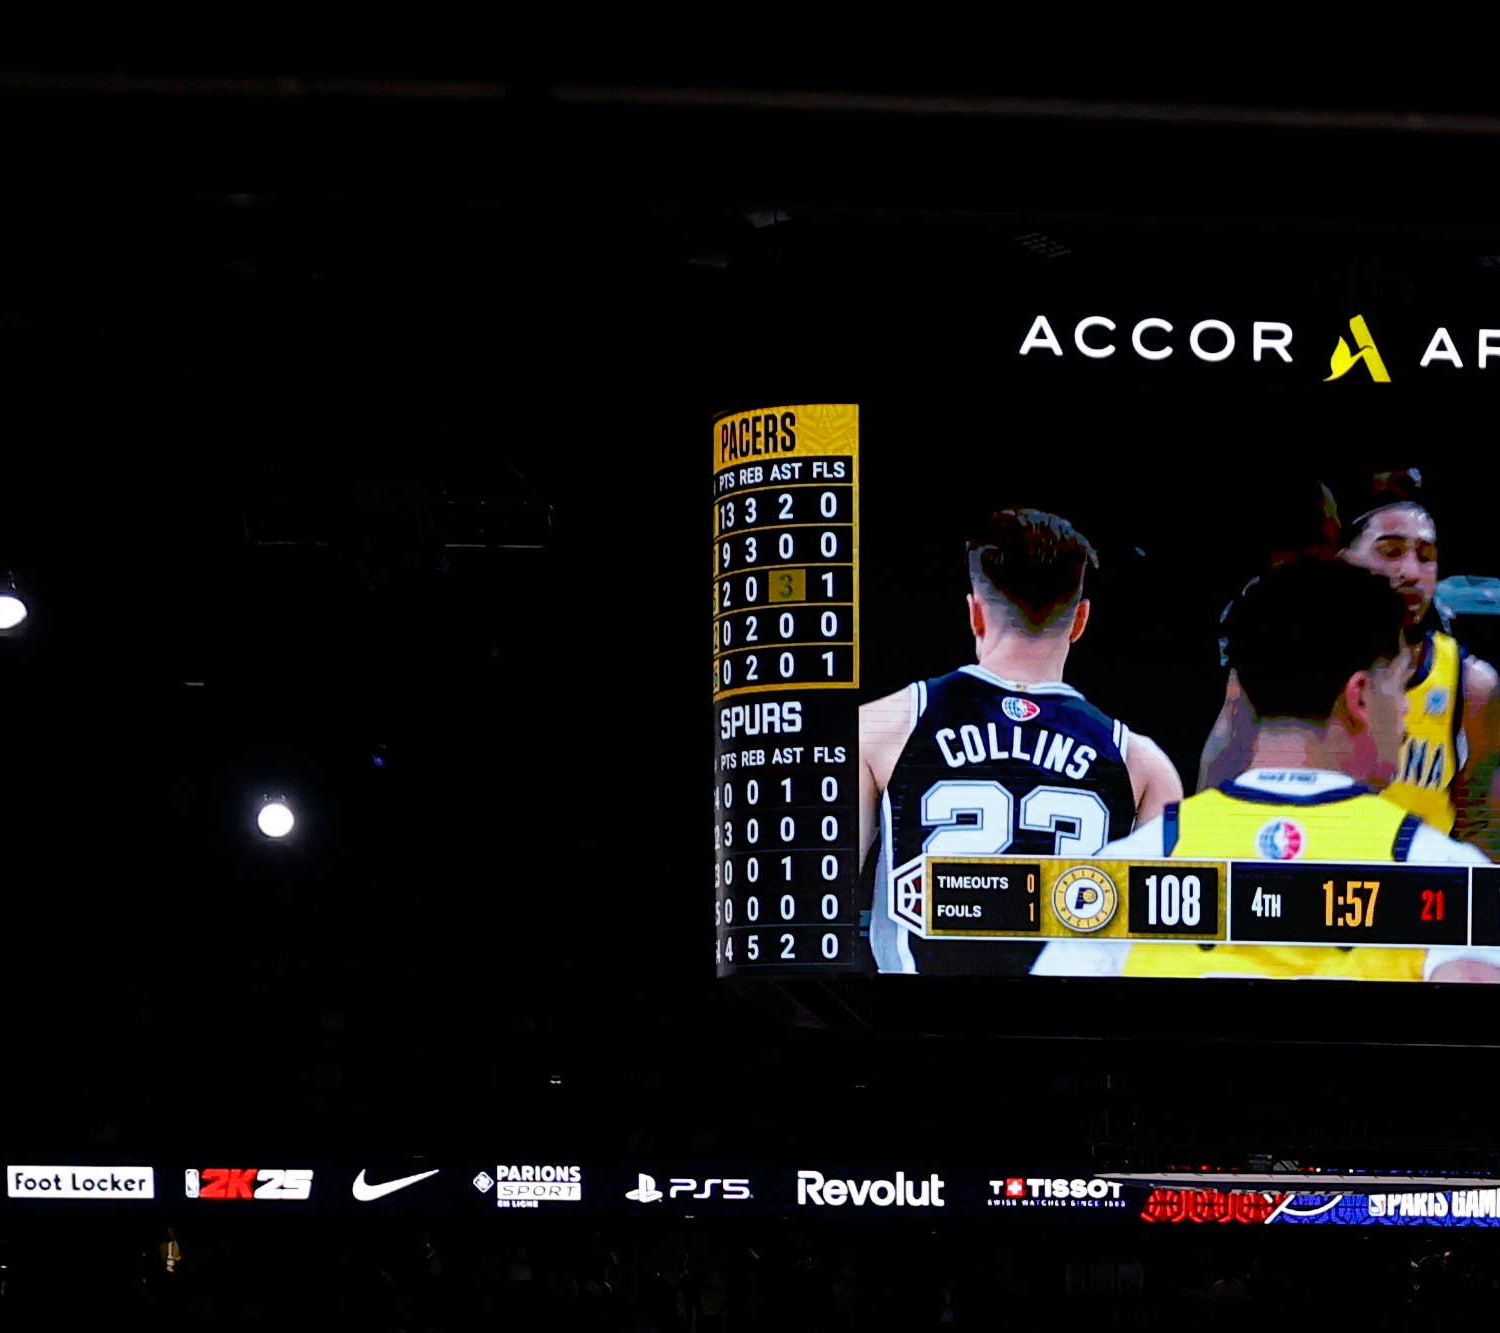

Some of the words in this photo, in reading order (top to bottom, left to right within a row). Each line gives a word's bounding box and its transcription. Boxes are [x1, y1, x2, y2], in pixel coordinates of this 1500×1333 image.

[1019, 315, 1294, 363] ACCOR
[721, 411, 797, 464] PACERS
[719, 471, 735, 492] PTS
[739, 467, 763, 486] REB
[770, 462, 802, 481] AST
[812, 461, 846, 478] FLS
[720, 502, 735, 529] 13
[745, 497, 757, 524] 3
[778, 493, 794, 520] 2
[820, 491, 838, 518] 0
[722, 542, 731, 569] 9
[745, 536, 757, 563] 3
[778, 533, 794, 560] 0
[820, 531, 838, 558] 0
[720, 700, 802, 740] SPURS
[720, 752, 737, 772] PTS
[741, 749, 766, 767] REB
[772, 747, 804, 765] AST
[813, 747, 846, 764] FLS
[935, 722, 1098, 780] COLLINS
[921, 779, 1110, 857] 23
[937, 875, 1009, 891] TIMEOUTS
[1026, 873, 1035, 894] 0
[937, 904, 982, 919] FOULS
[1029, 902, 1035, 923] 1
[1145, 874, 1200, 927] 108
[1251, 887, 1281, 918] 4TH
[1322, 879, 1380, 927] 1:57
[1420, 890, 1445, 921] 21
[724, 935, 733, 962] 4
[747, 934, 759, 961] 5
[780, 933, 796, 959] 2
[821, 932, 839, 959] 0
[15, 1172, 62, 1191] Foot
[71, 1173, 146, 1192] Locker
[199, 1168, 314, 1199] 2K25
[497, 1165, 581, 1182] PARIONS
[669, 1178, 750, 1200] PS5
[797, 1170, 945, 1207] Revolut
[1026, 1178, 1124, 1199] TISSOT
[501, 1185, 576, 1196] SPORT
